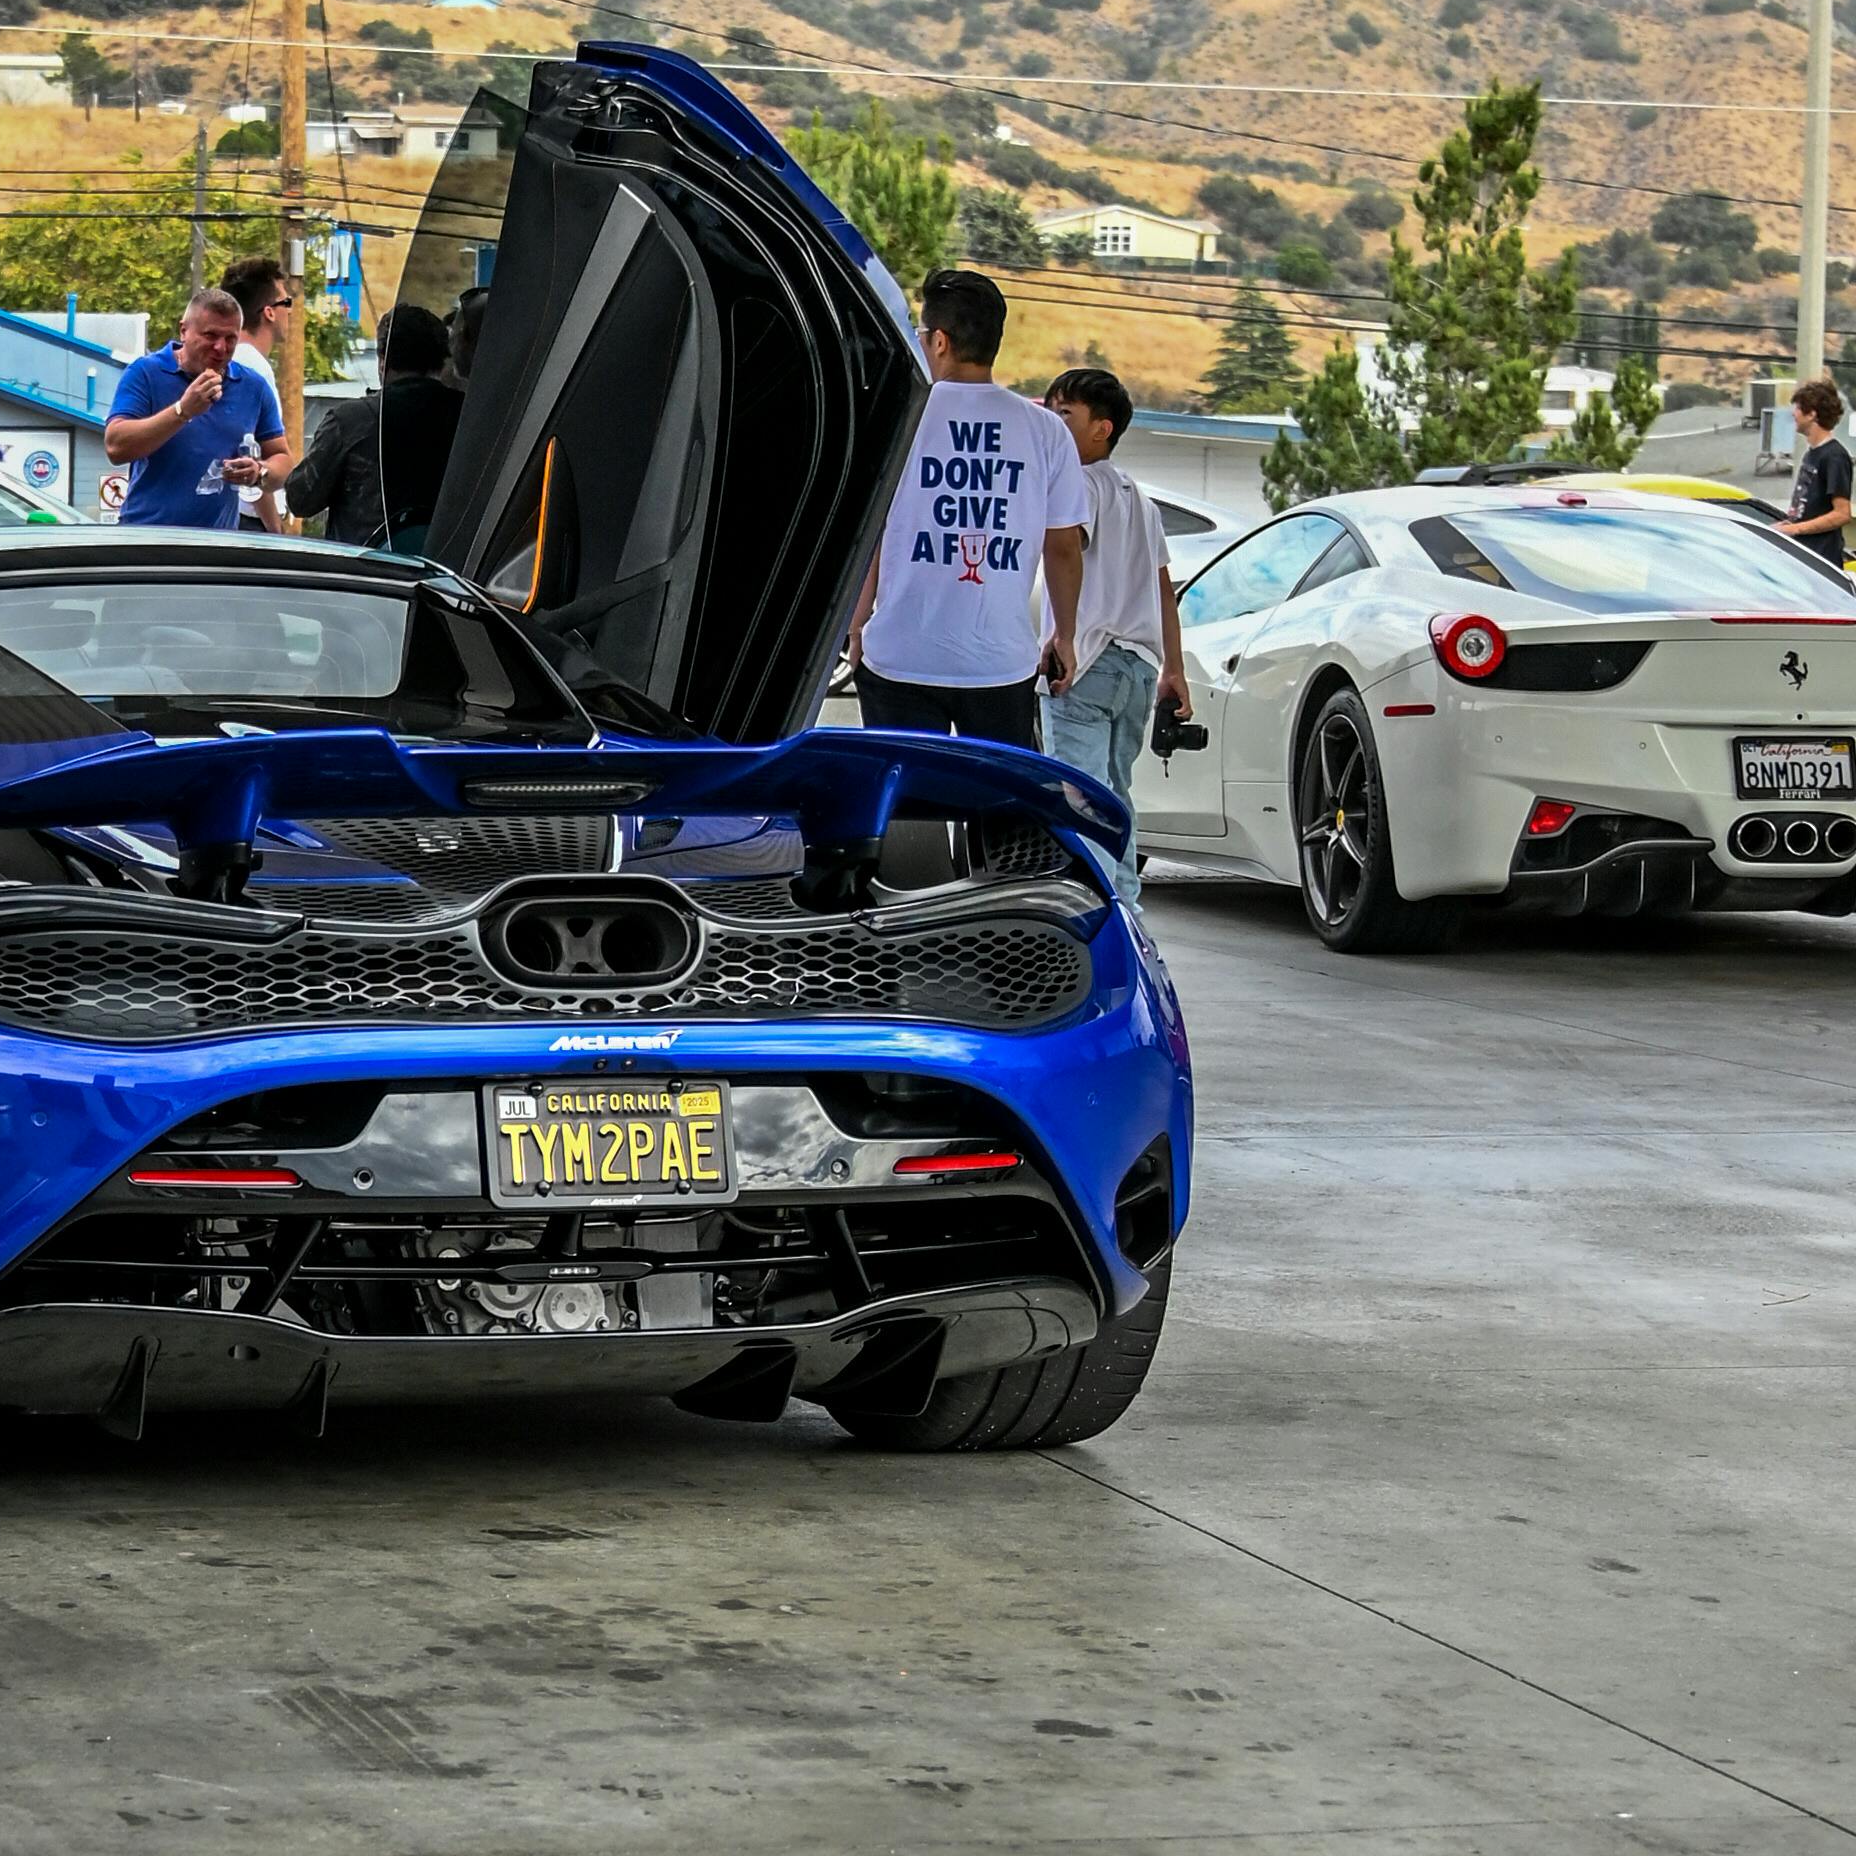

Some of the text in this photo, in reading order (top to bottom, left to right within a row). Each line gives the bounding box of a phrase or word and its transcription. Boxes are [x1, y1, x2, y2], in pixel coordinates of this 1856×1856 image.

[949, 421, 1001, 453] WE
[921, 457, 1024, 493] DON'T
[933, 495, 1008, 530] GIVE
[911, 531, 935, 562] A
[1760, 743, 1831, 760] California
[1746, 761, 1844, 789] 8NMD391
[1779, 789, 1821, 799] Ferrari
[549, 1033, 676, 1051] McLaren
[505, 1100, 530, 1116] JUL
[547, 1094, 672, 1113] CALIFORNIA
[500, 1121, 719, 1184] TYM2PAE
